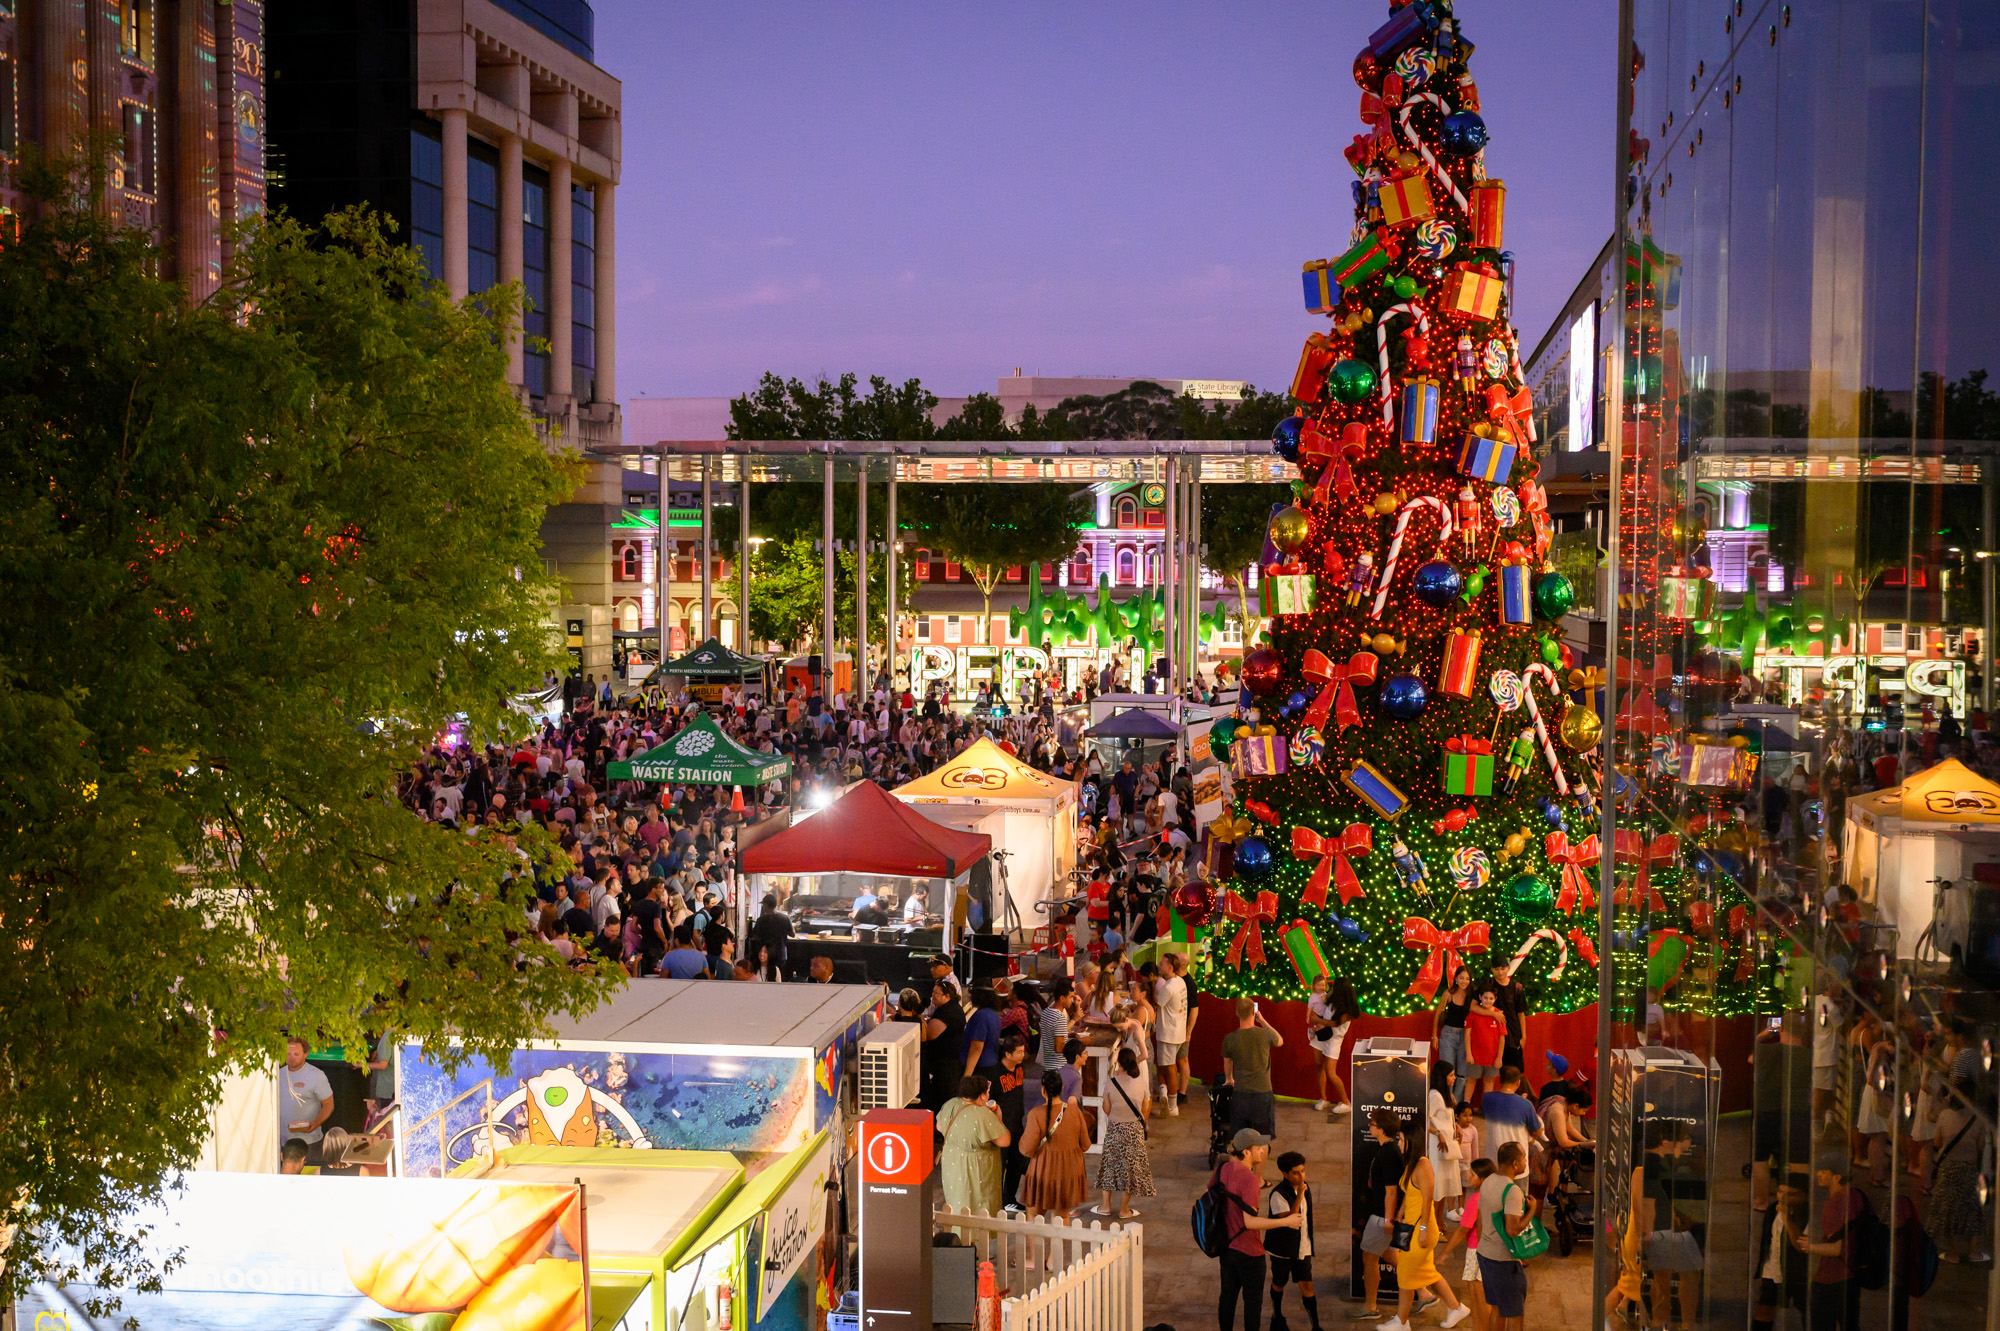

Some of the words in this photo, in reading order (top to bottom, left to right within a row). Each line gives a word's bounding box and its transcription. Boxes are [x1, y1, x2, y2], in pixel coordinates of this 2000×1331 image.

[1217, 383, 1241, 392] Library
[631, 765, 674, 780] WASTE
[678, 767, 732, 782] STATION
[1360, 1104, 1378, 1112] CITY
[1392, 1106, 1418, 1114] PERTH
[781, 1221, 808, 1276] STATION
